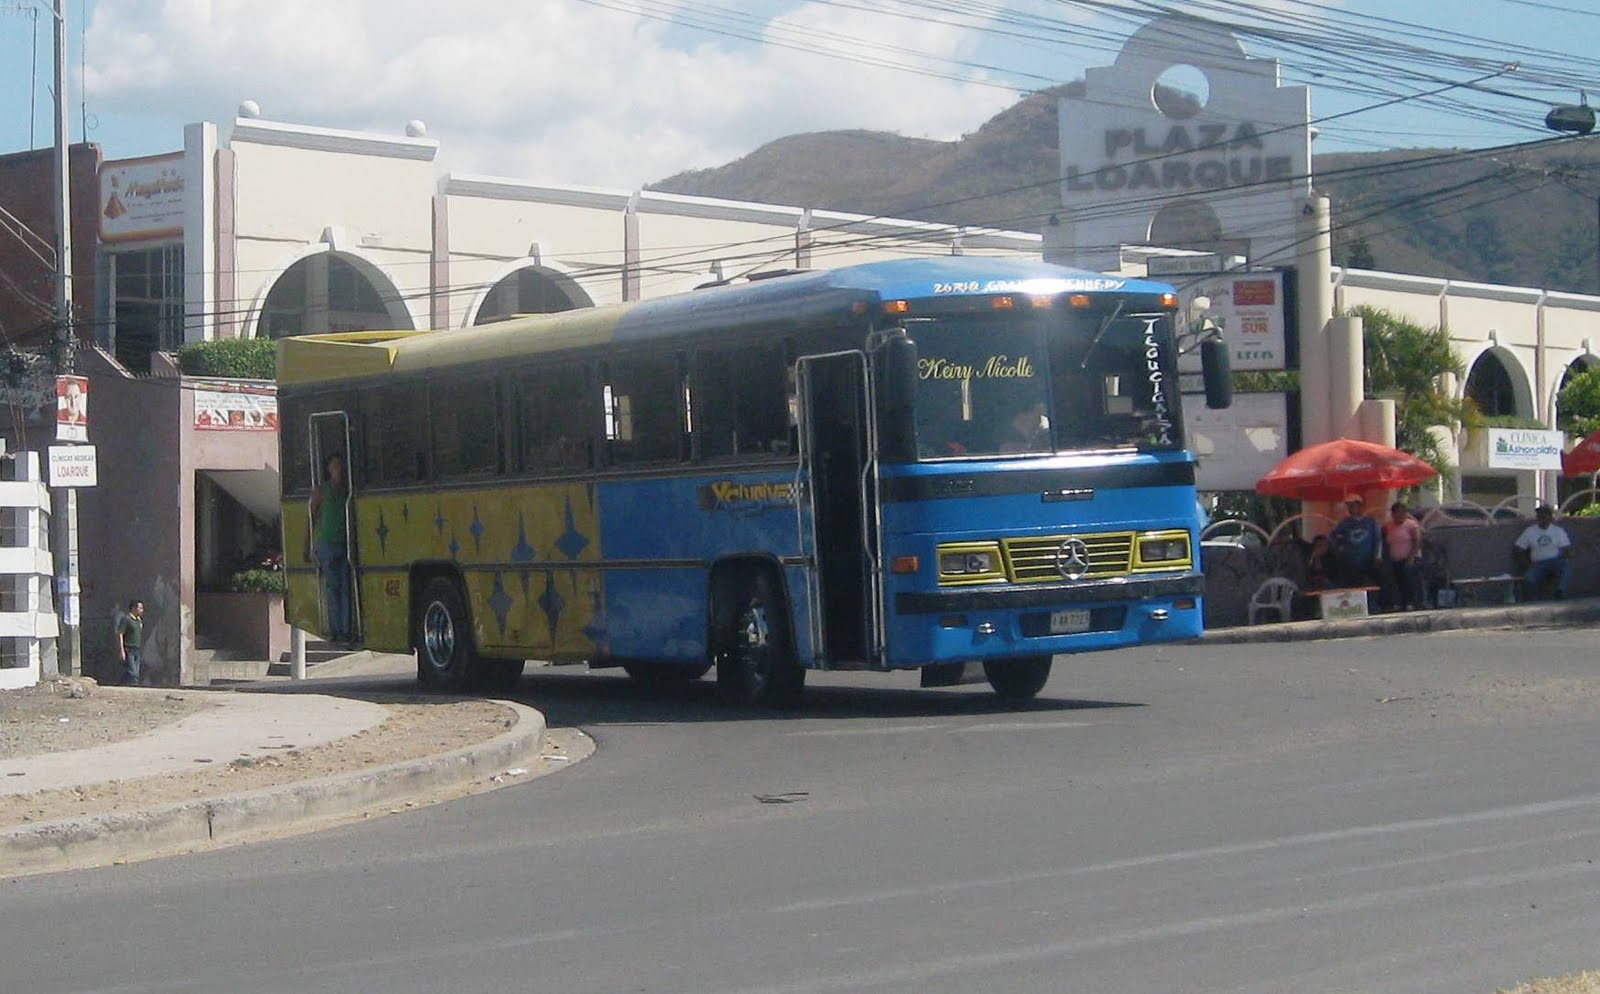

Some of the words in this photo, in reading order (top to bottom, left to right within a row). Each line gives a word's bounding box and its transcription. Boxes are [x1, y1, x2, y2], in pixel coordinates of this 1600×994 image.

[1104, 122, 1264, 158] PLAZA
[1066, 156, 1293, 192] LOARQUE
[57, 465, 89, 477] LOARQUE
